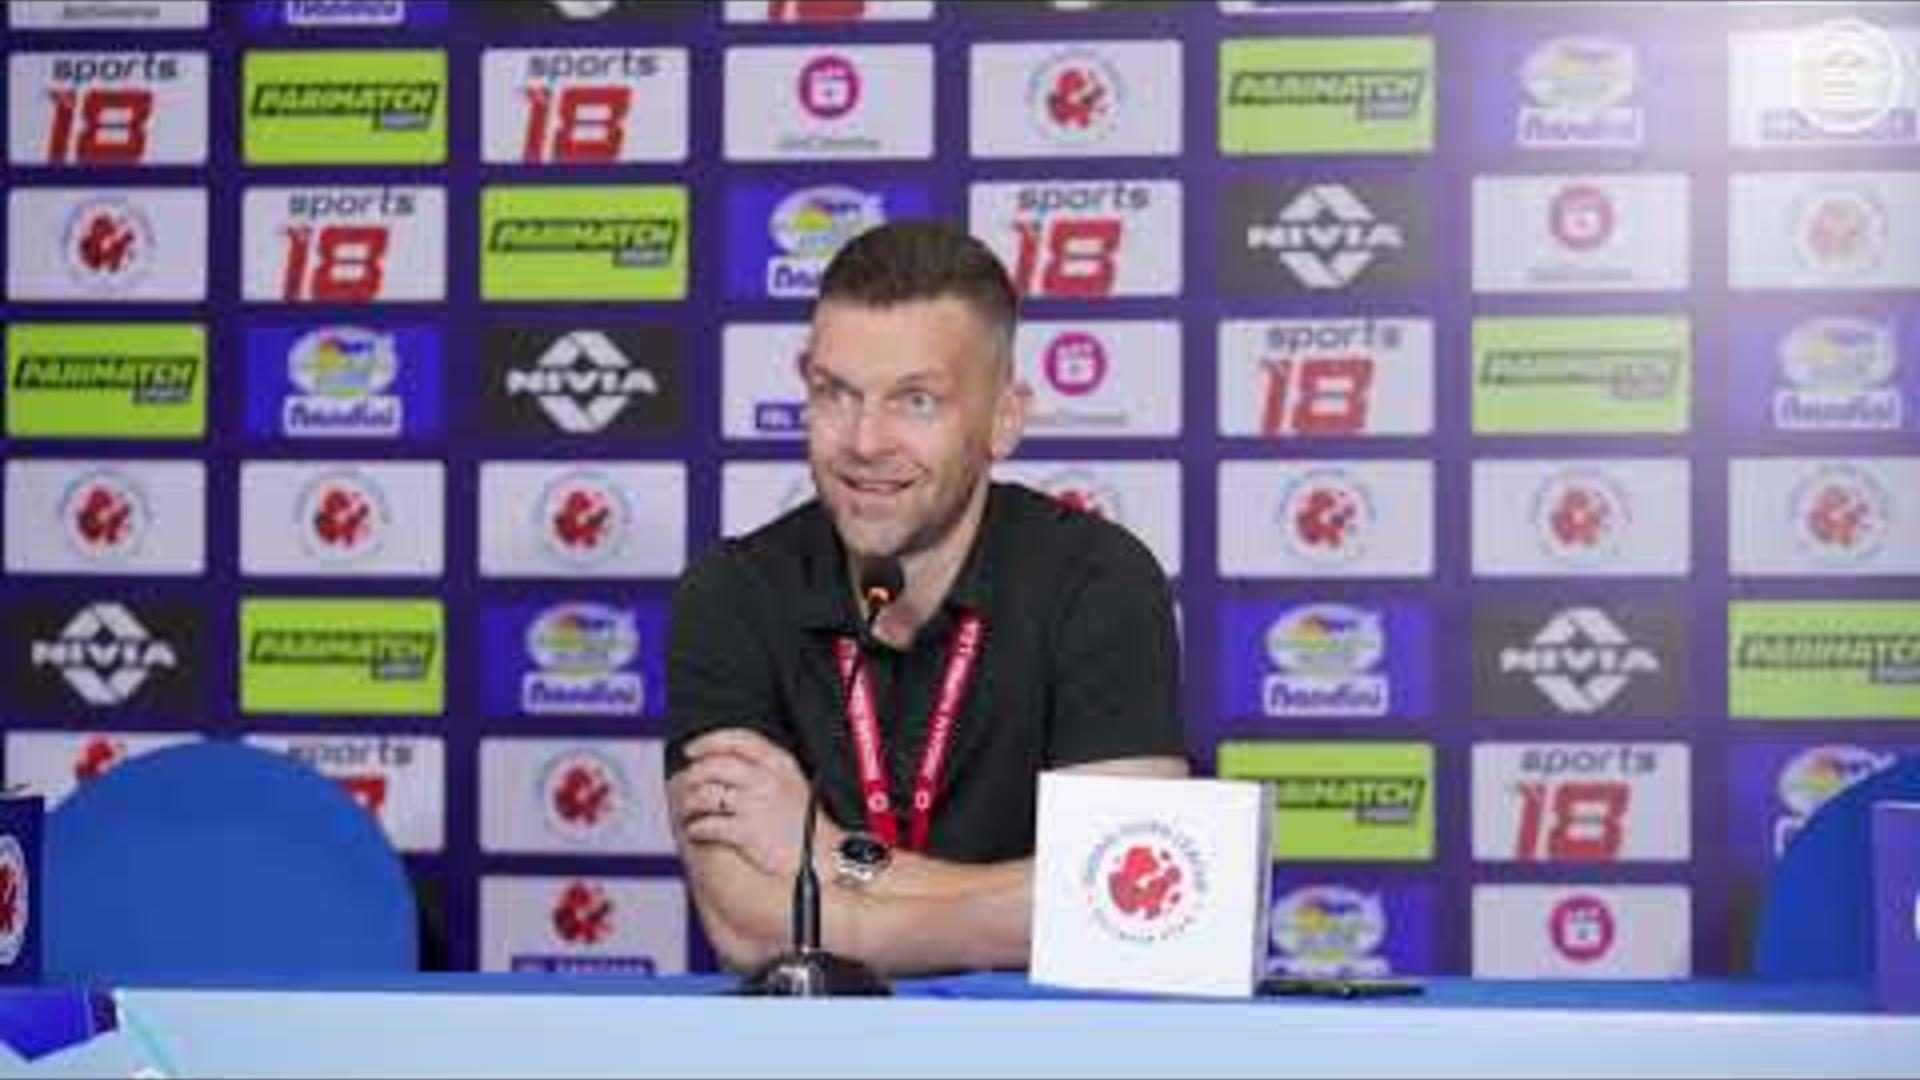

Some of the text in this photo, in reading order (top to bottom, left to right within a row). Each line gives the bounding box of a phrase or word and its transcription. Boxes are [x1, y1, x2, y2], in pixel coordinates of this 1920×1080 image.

[53, 54, 178, 82] sports
[528, 48, 660, 78] sports
[258, 87, 435, 112] PARIMATCH
[47, 89, 153, 165] 18
[521, 86, 633, 165] 18
[288, 186, 416, 217] sports
[1017, 184, 1150, 215] sports
[1247, 225, 1405, 249] NIVIA
[280, 225, 390, 302] 18
[1267, 314, 1402, 350] sports
[20, 360, 195, 386] PARIMATCH
[506, 368, 659, 395] NIVIA
[1258, 357, 1374, 438] 18
[31, 640, 178, 667] NIVIA
[1499, 646, 1661, 673] NIVIA
[1519, 747, 1658, 777] sports
[1512, 780, 1631, 861] 18
